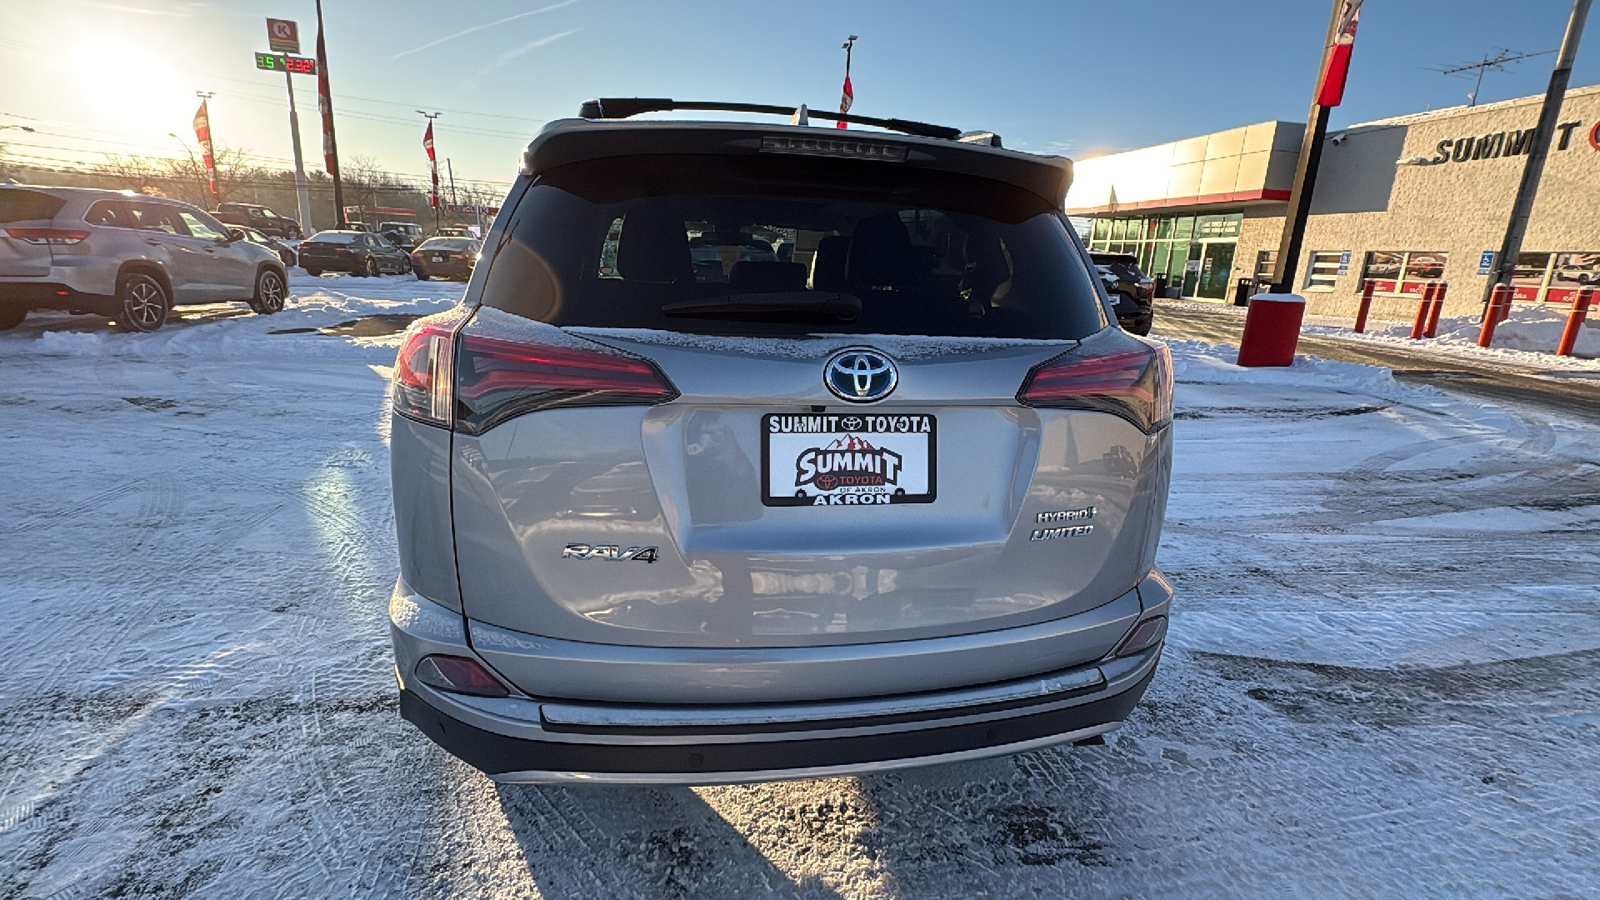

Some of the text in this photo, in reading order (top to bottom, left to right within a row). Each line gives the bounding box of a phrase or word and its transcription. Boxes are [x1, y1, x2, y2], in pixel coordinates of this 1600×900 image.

[275, 23, 290, 38] K
[1433, 119, 1582, 164] SUMMT
[769, 415, 931, 433] SUMMIT TOYOTA
[799, 450, 899, 483] SUMMIT
[839, 475, 884, 485] TOYOTA
[812, 494, 891, 506] AKRON
[1037, 509, 1088, 523] HYBRID
[1030, 524, 1094, 541] LIMITED
[561, 542, 659, 564] RAV4
